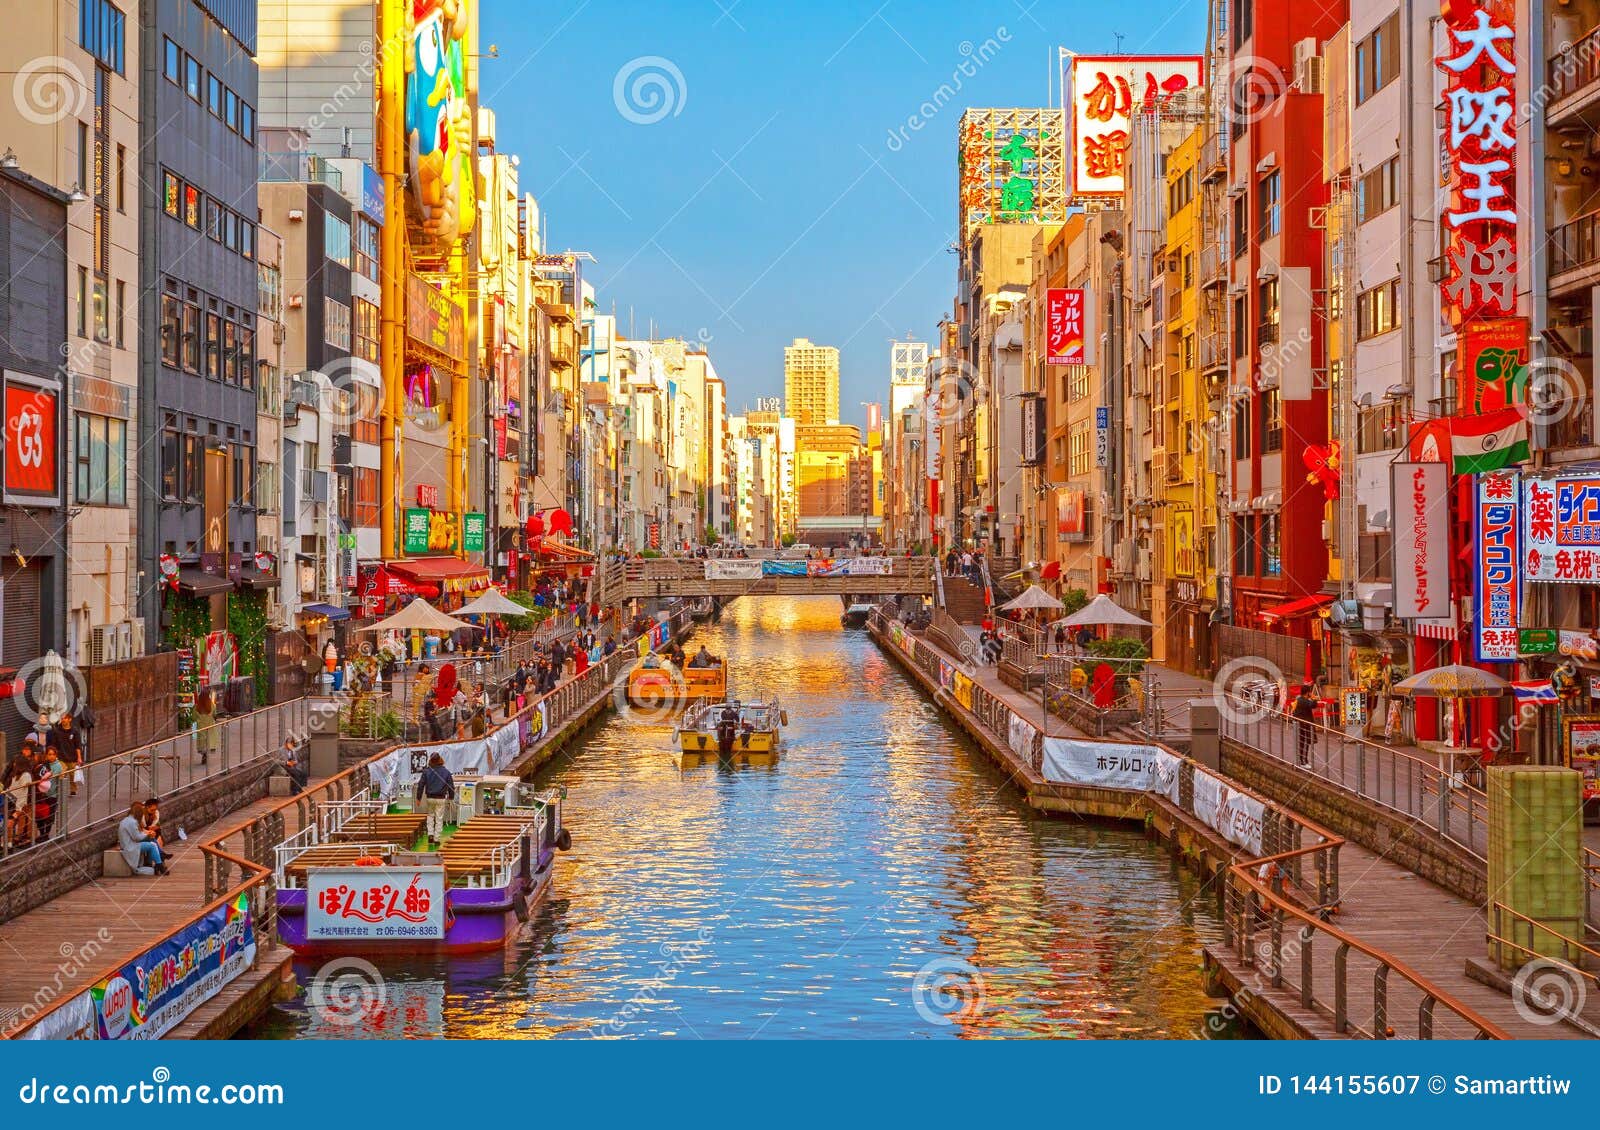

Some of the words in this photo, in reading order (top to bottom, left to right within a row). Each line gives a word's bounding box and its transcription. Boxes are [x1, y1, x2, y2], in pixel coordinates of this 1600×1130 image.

[999, 134, 1035, 212] 千房
[1442, 10, 1516, 311] 大阪王将
[1051, 300, 1064, 346] ドラッグ
[1065, 293, 1080, 335] ツルハ
[18, 412, 43, 468] G3
[1530, 482, 1554, 541] 薬
[1413, 467, 1429, 612] よしもとエンタメショップ
[1486, 506, 1513, 584] ダイコク
[1555, 550, 1592, 579] 免税
[1482, 630, 1517, 645] 免税
[319, 880, 431, 922] ぽんぽん船
[384, 926, 438, 936] 06-6946-8363
